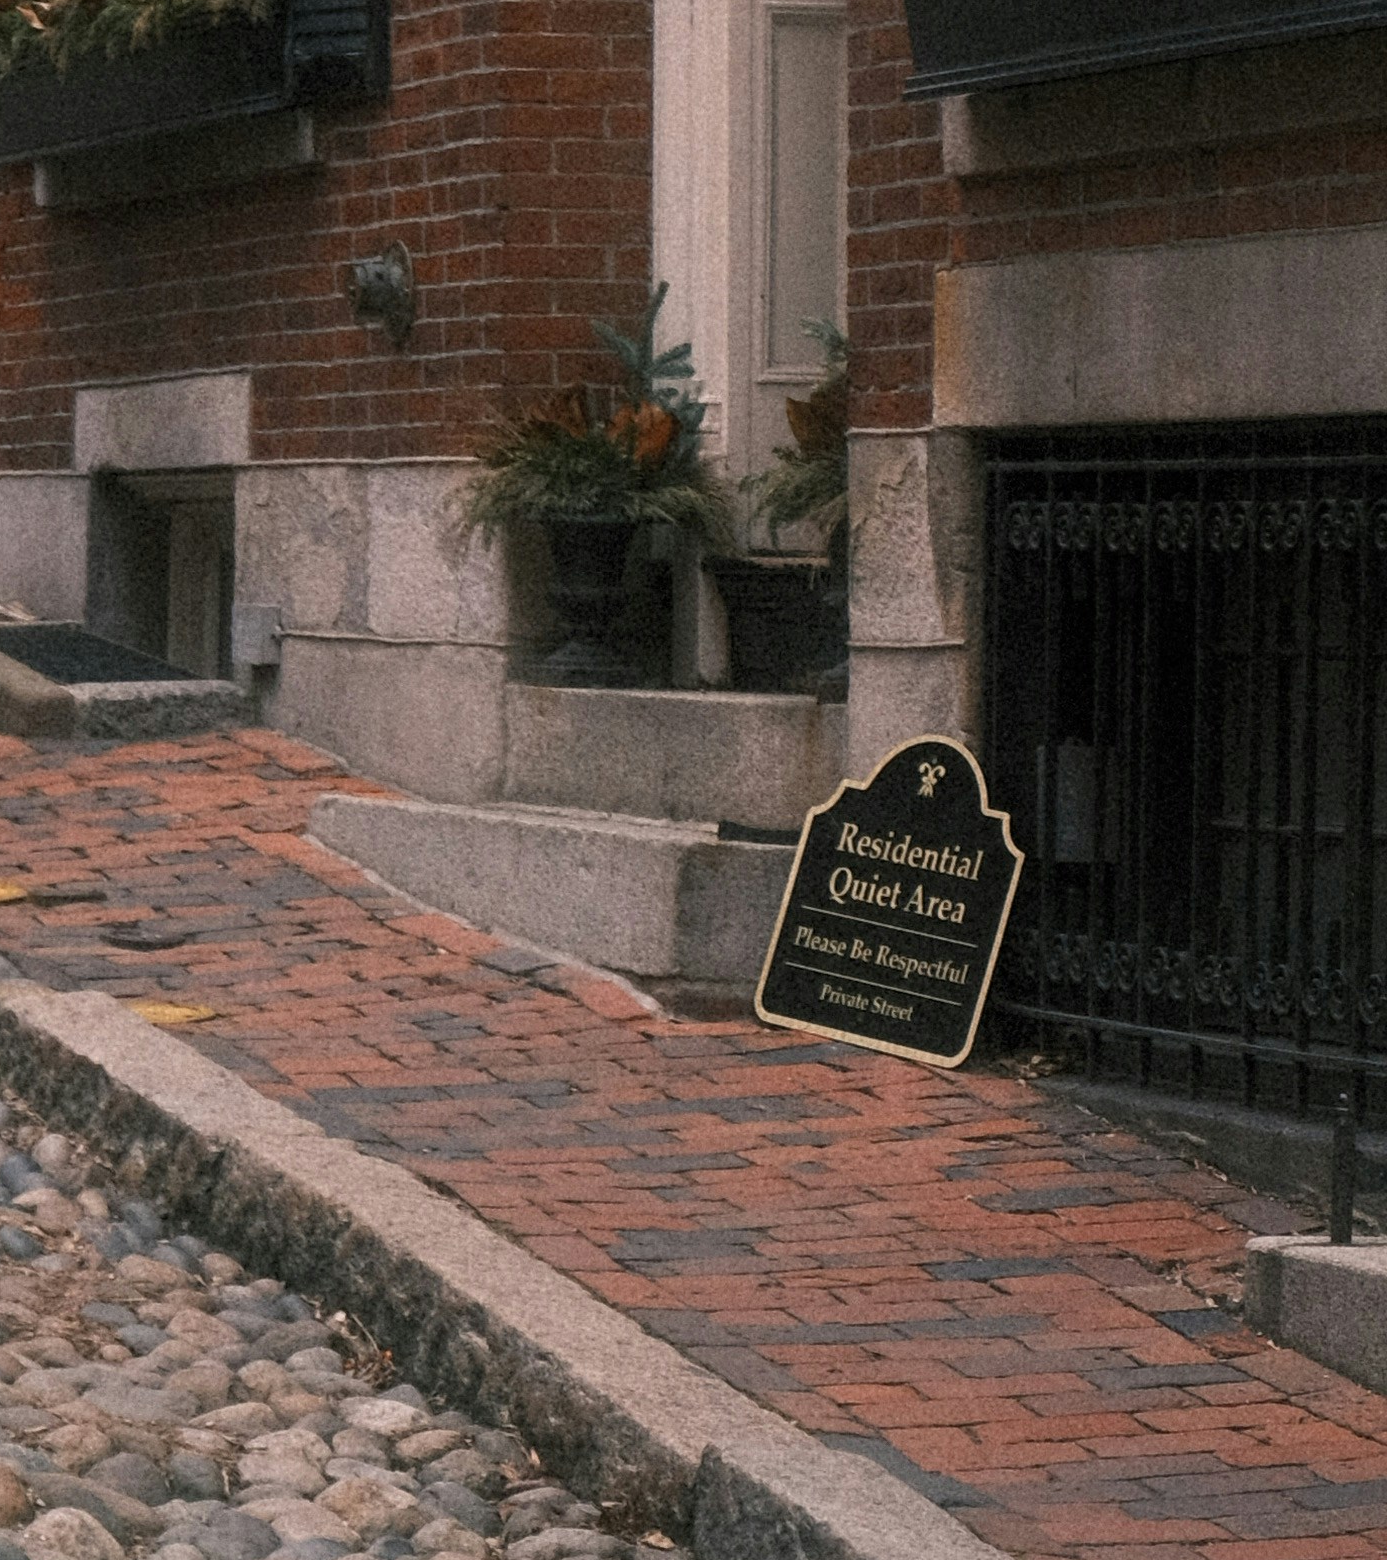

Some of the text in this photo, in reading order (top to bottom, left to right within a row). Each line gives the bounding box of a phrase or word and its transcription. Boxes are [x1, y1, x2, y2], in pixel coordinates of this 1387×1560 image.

[836, 823, 983, 880] Residential
[829, 867, 966, 923] Quiet Area
[794, 926, 970, 984] Please Be Respectful
[819, 984, 914, 1021] Private Street
